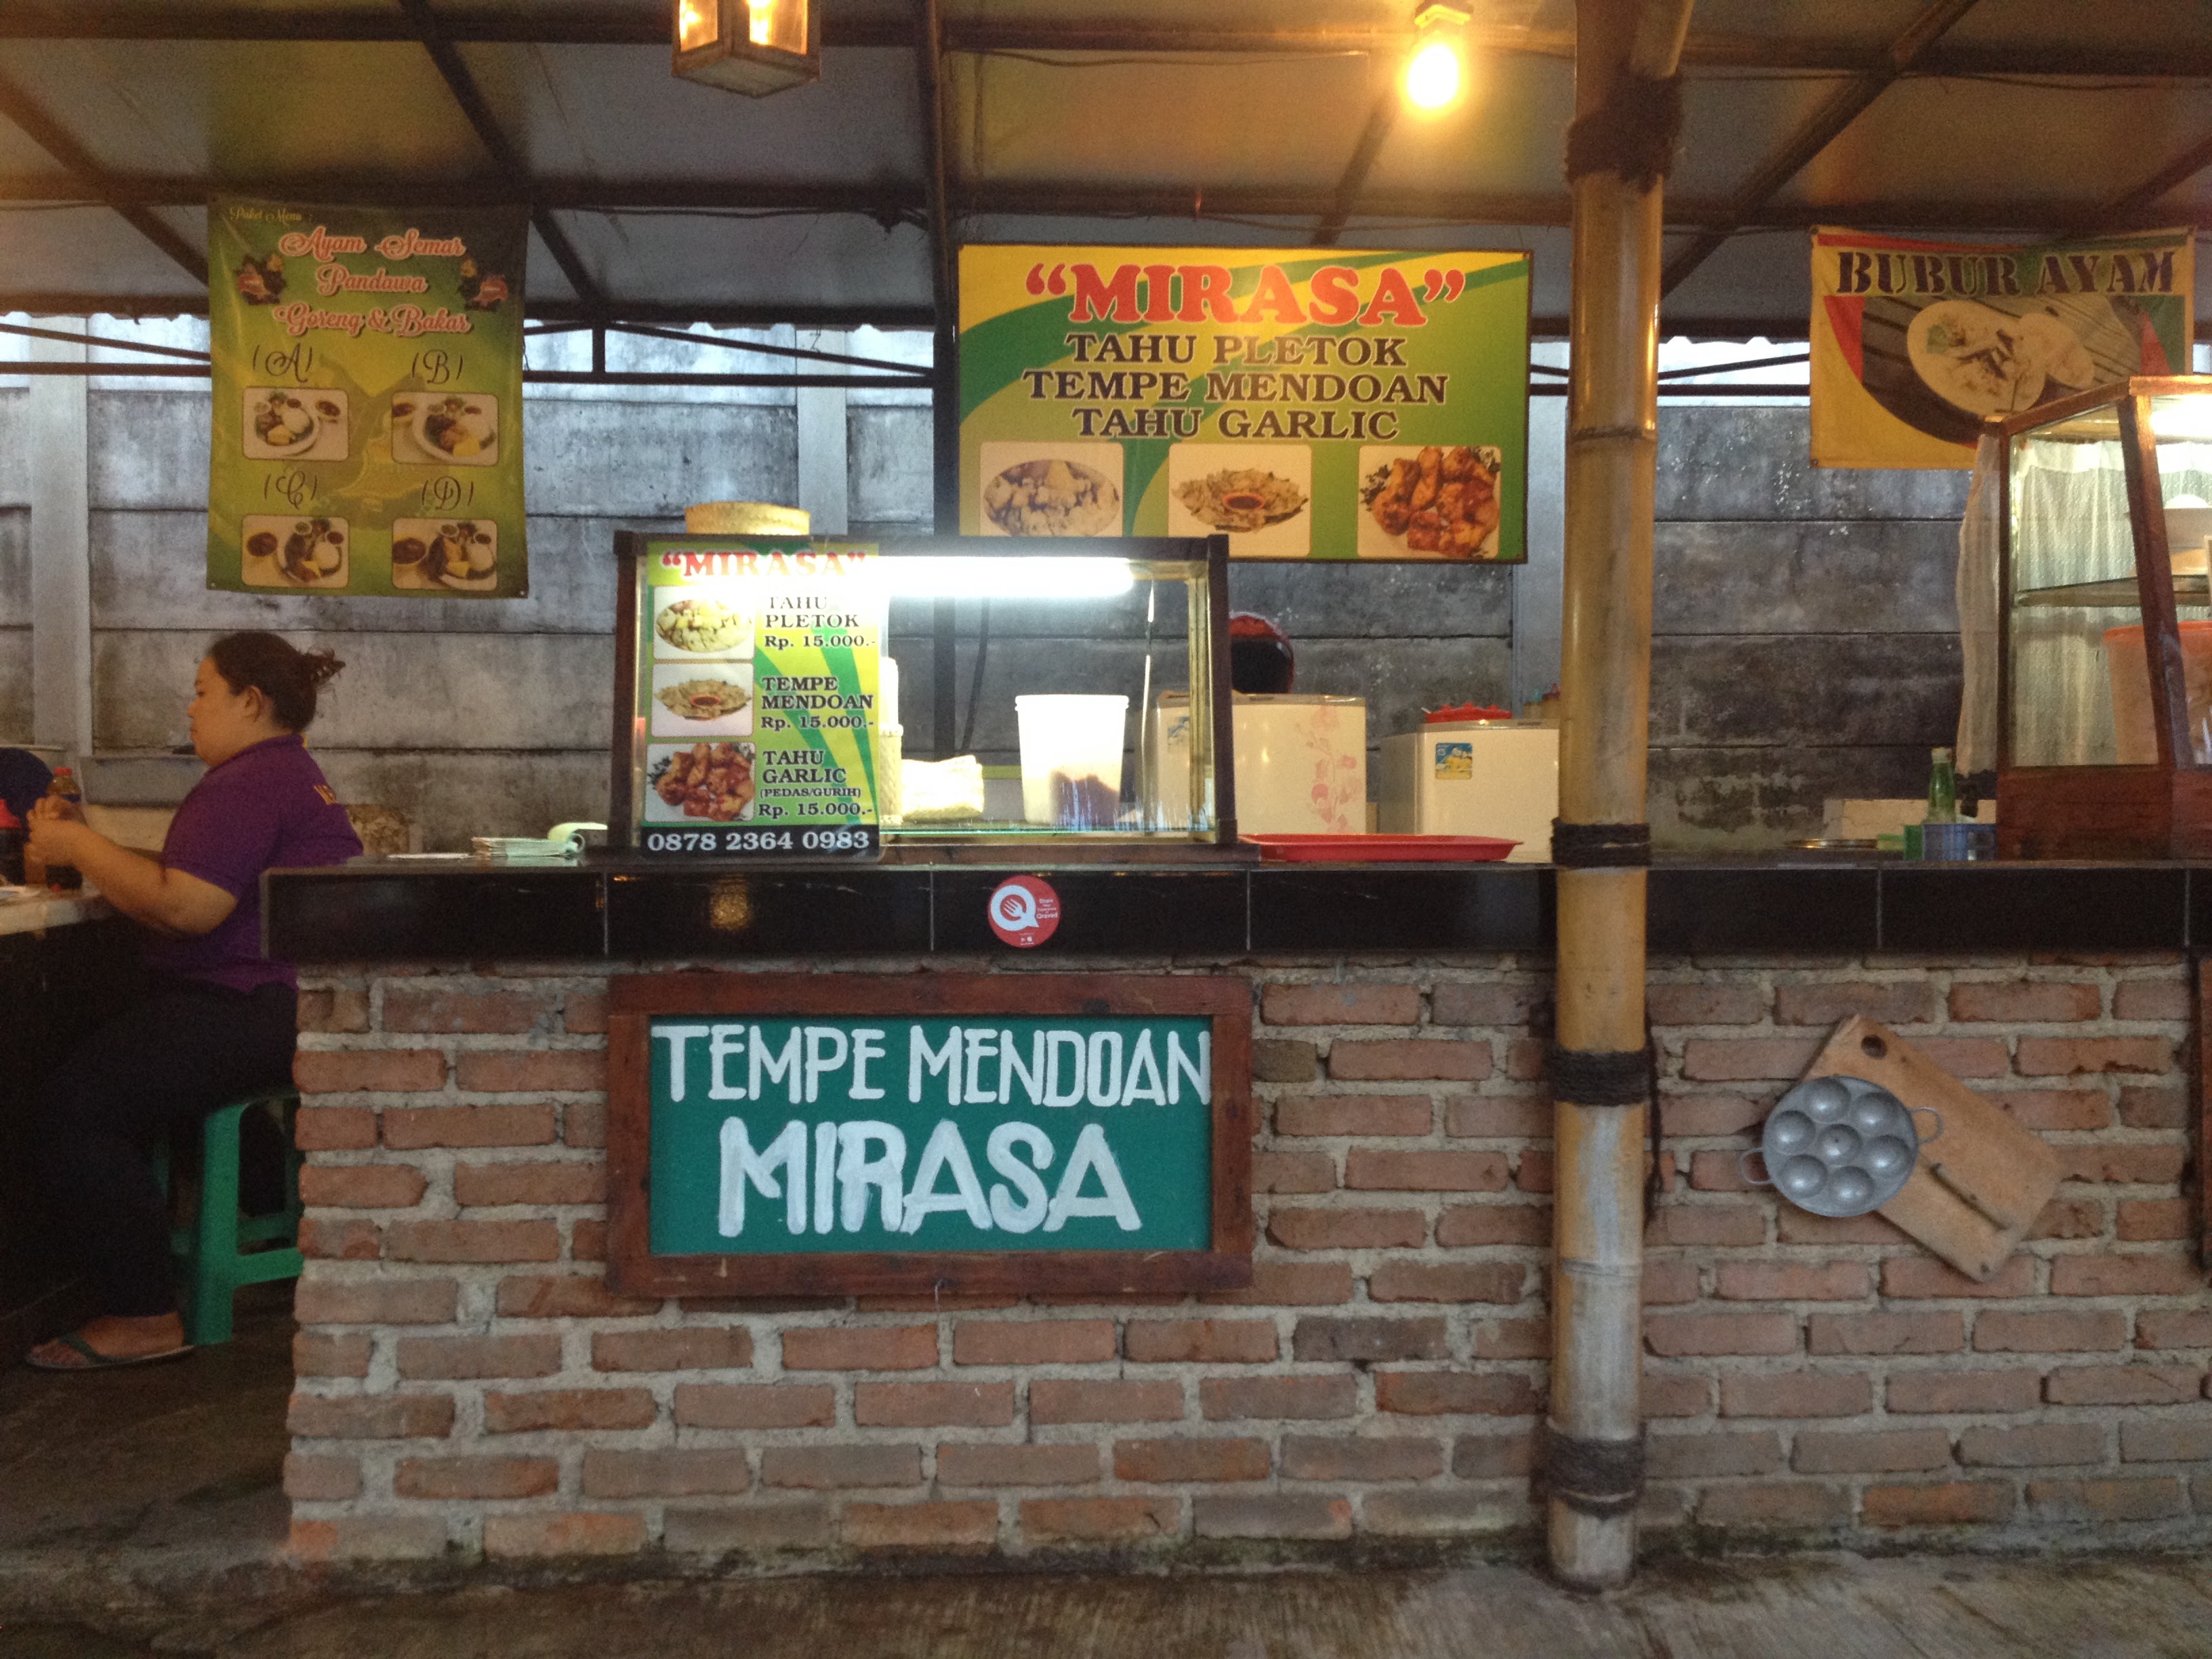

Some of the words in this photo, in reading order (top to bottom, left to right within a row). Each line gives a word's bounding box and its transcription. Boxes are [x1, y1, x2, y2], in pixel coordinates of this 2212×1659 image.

[278, 225, 367, 262] Ayam
[374, 228, 467, 260] Semar
[314, 262, 429, 296] Pandawa
[1836, 251, 2020, 296] BUBUR
[2036, 251, 2175, 295] AYAM
[272, 302, 365, 337] Goreng
[368, 307, 392, 333] &
[390, 303, 472, 337] Bakar
[1064, 333, 1196, 364] TAHU
[1212, 333, 1408, 367] PLETOK
[1023, 370, 1191, 401] TEMPE
[1204, 372, 1450, 405] MENDOAN
[1071, 407, 1202, 438] TAHU
[1218, 408, 1399, 441] GARLIC
[769, 596, 827, 610] TAHU
[764, 613, 859, 629] PLETOK
[764, 635, 794, 651] Rp.
[802, 634, 876, 648] 15.000.-
[762, 676, 838, 691] TEMPE
[761, 694, 874, 710] MENDOAN
[760, 716, 792, 732] Rp.
[800, 716, 874, 729] 15.000.-
[762, 750, 824, 766] TAHU
[762, 768, 846, 784] GARLIC
[760, 787, 861, 799] (PEDAS/GURIH)
[758, 802, 789, 819] Rp.
[797, 802, 874, 817] 15.000.-
[647, 832, 717, 852] 0878
[725, 832, 793, 851] 2364
[802, 830, 869, 849] 0983
[651, 1024, 886, 1103] TEMPE
[908, 1025, 1211, 1107] MENDOAN
[718, 1115, 1143, 1237] MIRASA
